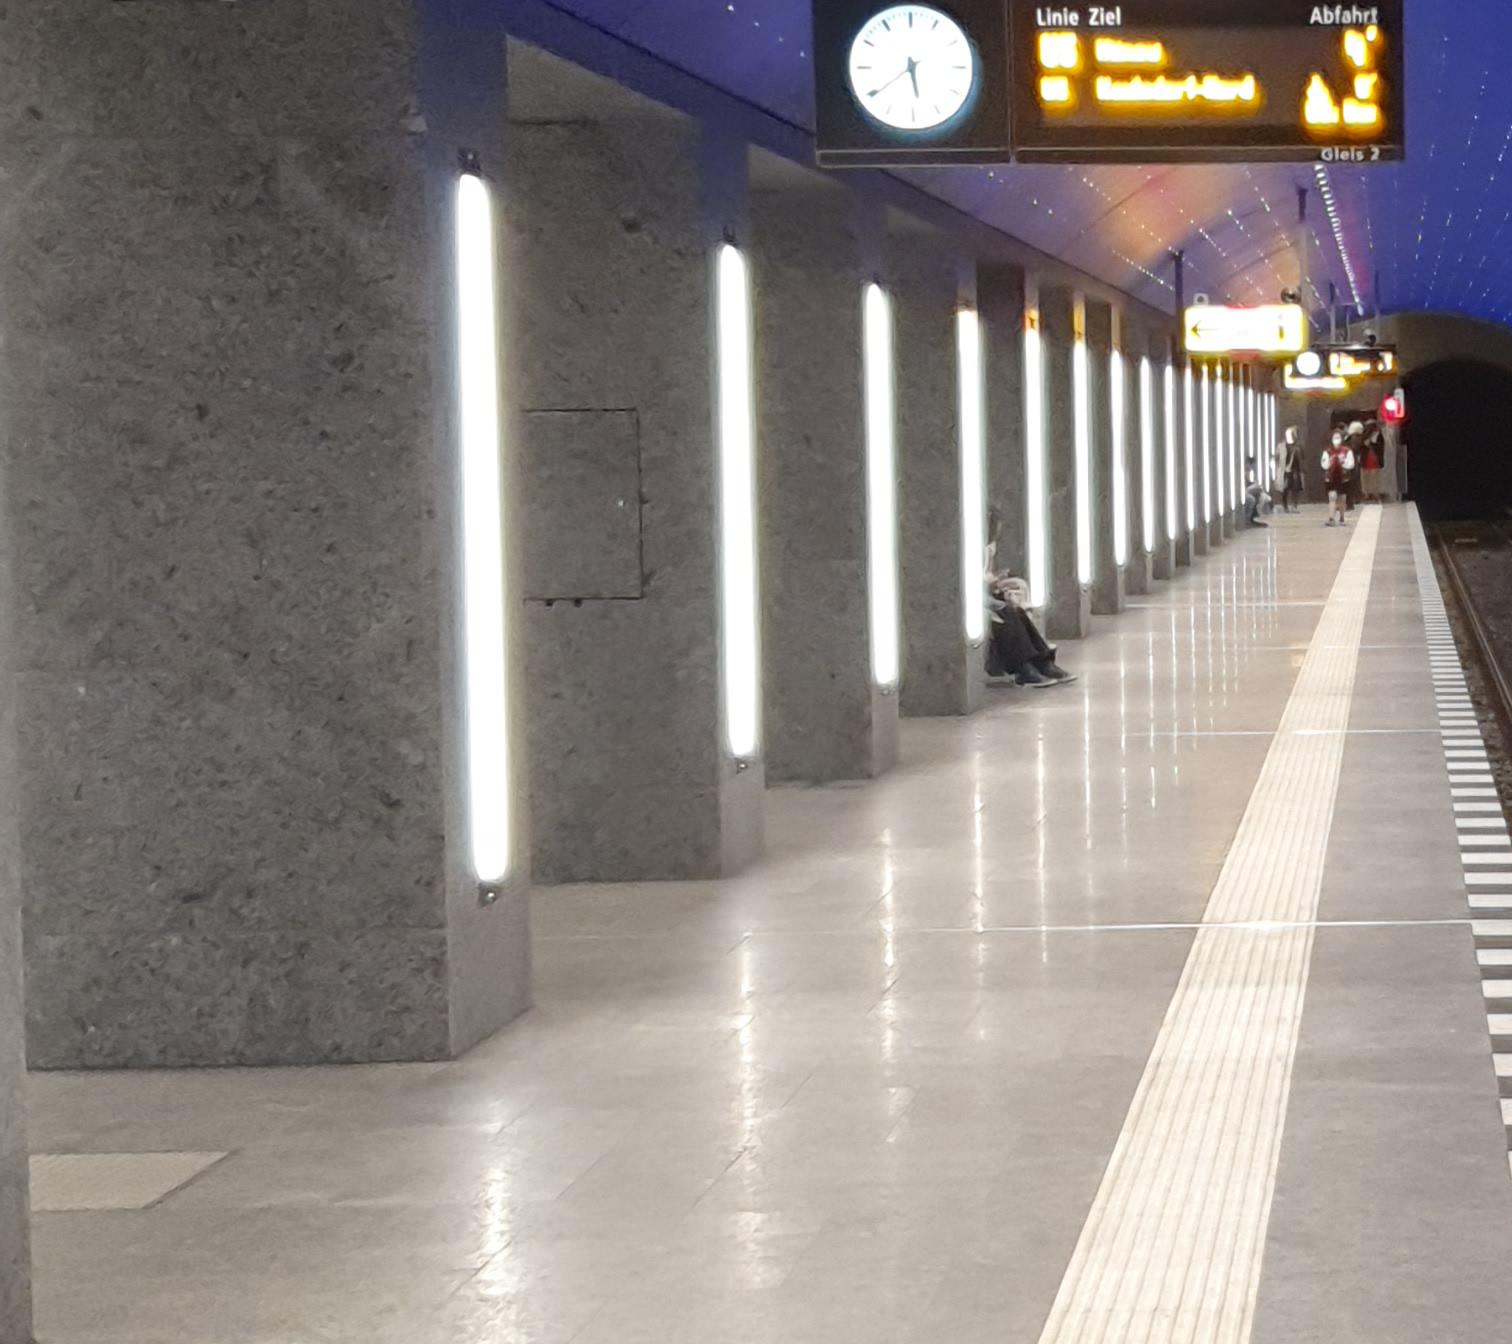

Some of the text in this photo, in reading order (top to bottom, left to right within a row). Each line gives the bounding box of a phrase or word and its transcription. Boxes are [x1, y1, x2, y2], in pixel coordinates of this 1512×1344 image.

[1036, 5, 1121, 27] Linie Ziel
[1309, 4, 1379, 25] Abfahrt
[1321, 146, 1364, 162] Gleis
